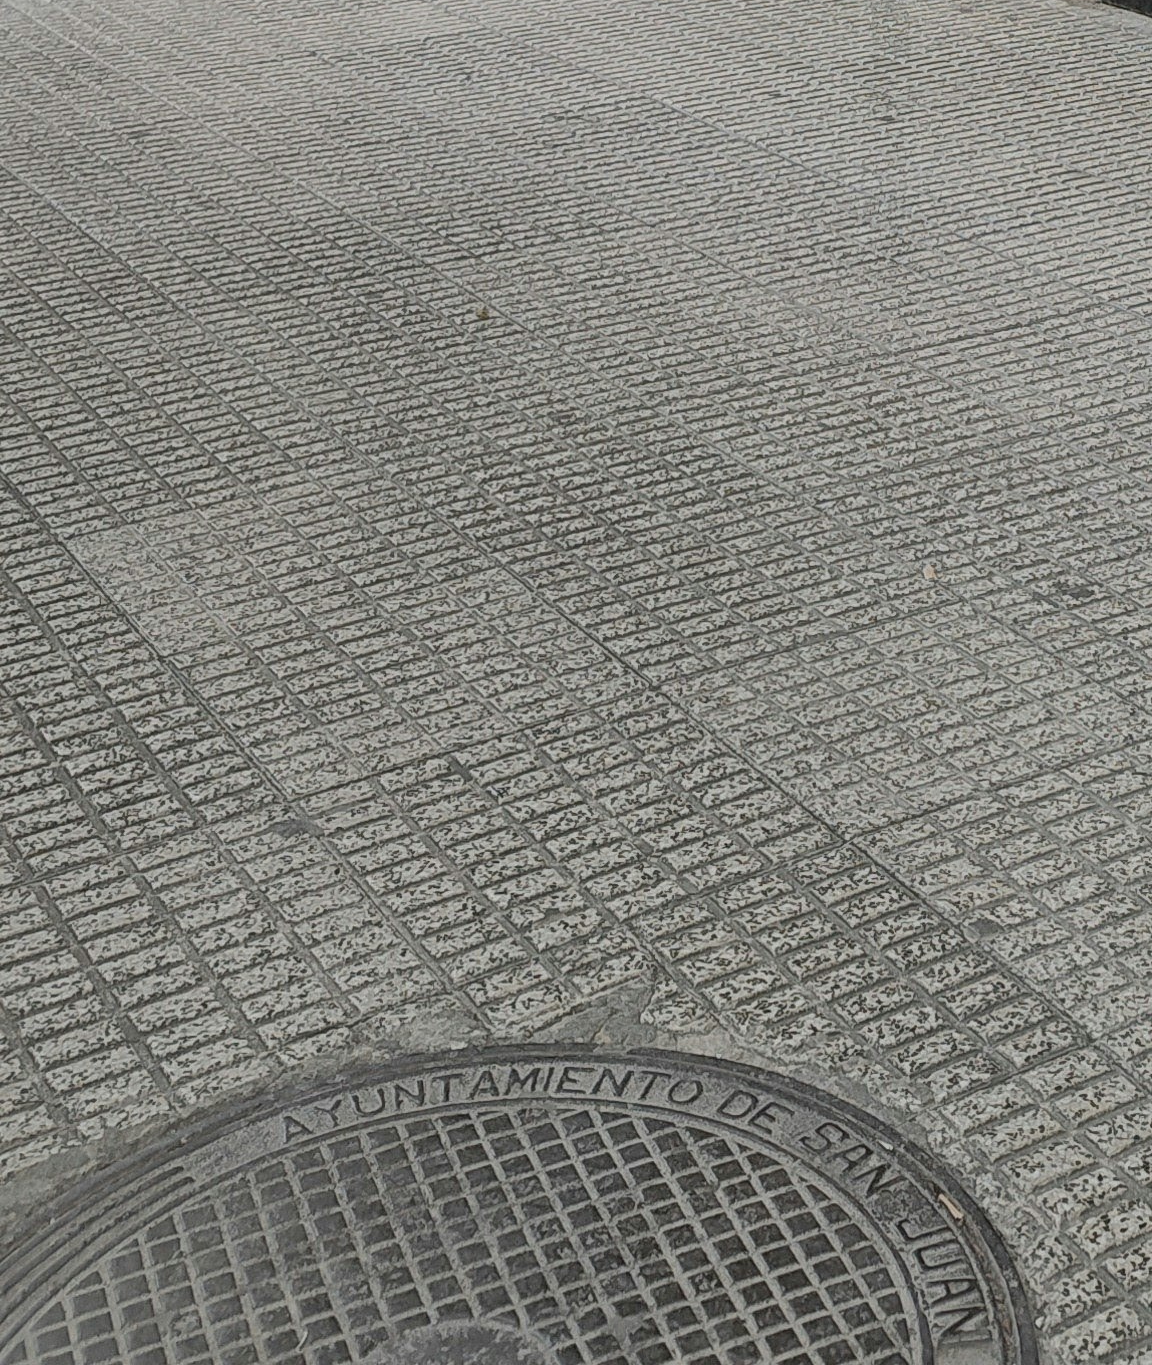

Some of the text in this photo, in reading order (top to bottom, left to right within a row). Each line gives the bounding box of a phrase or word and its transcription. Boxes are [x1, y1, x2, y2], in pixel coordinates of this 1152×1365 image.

[282, 1067, 993, 1345] AYUNTAMIENTO DE SAN JUAN
